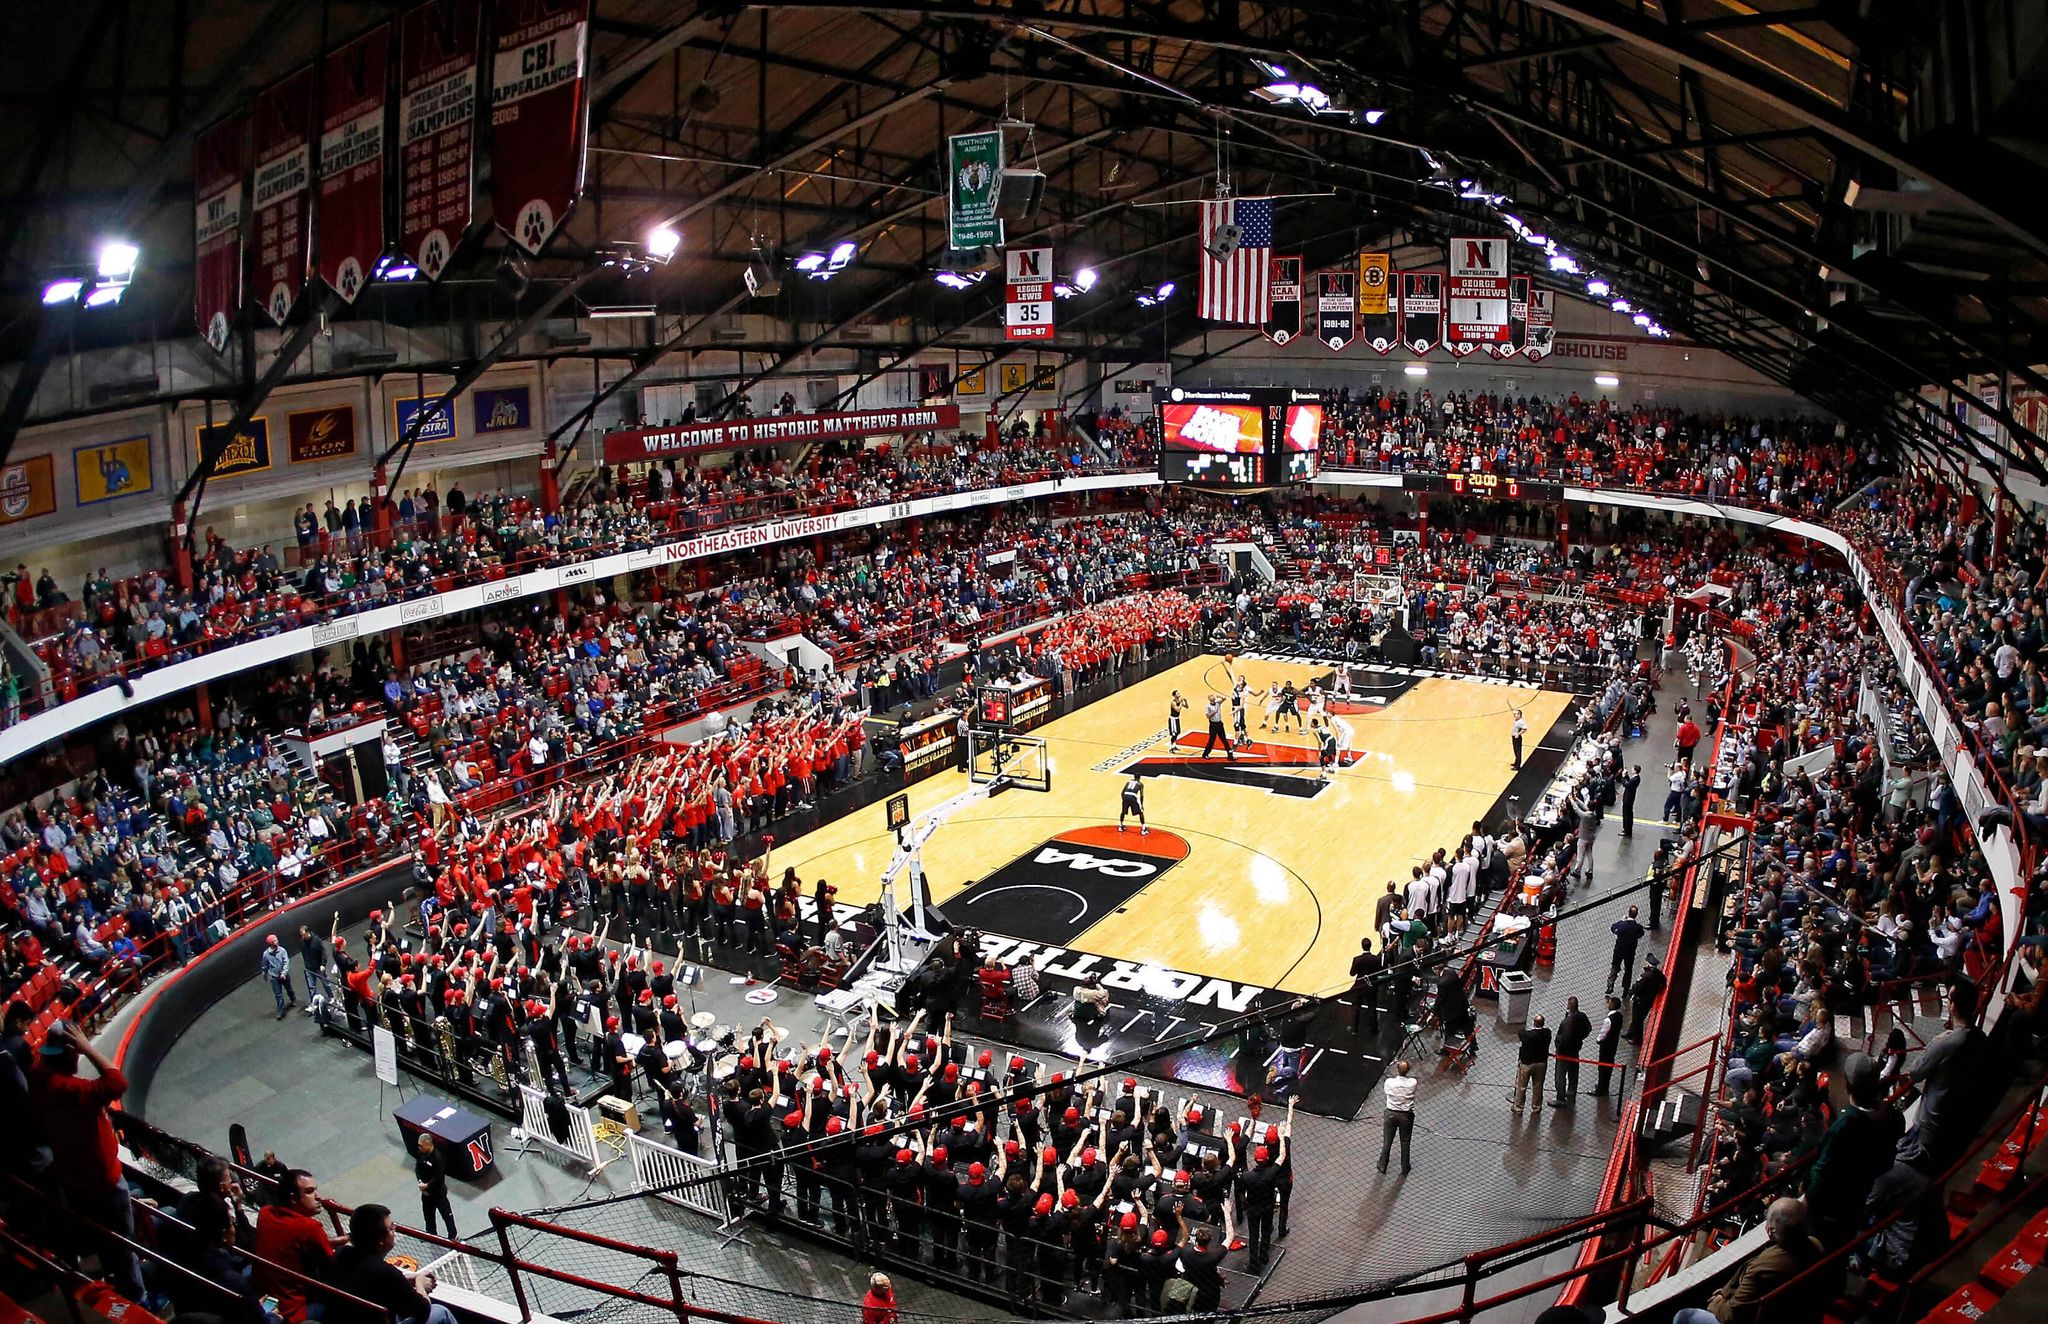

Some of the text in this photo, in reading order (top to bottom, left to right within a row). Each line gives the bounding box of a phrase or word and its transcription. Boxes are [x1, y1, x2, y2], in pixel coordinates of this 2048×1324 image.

[522, 39, 556, 74] CBI
[491, 105, 519, 125] 2009
[1467, 241, 1492, 269] N
[1019, 251, 1040, 277] N
[1328, 274, 1345, 293] N
[1369, 269, 1380, 284] B
[1413, 275, 1431, 294] N
[1462, 279, 1496, 288] GEORGE
[1016, 285, 1042, 293] REGGIE
[1017, 292, 1042, 301] LEWIS
[1451, 287, 1507, 297] MATTHEWS
[1020, 305, 1040, 322] 35
[1476, 302, 1482, 321] 1
[1323, 320, 1350, 328] 1981-82
[1458, 325, 1500, 333] CHAIRMAN
[1554, 342, 1628, 361] GHOUSE
[1184, 391, 1251, 400] Northeastern University
[1269, 406, 1281, 420] N
[485, 415, 520, 429] JMU
[643, 411, 938, 453] WELCOME TO HISTORIC MATTHEWS ARENA
[299, 441, 346, 454] ELON
[1455, 479, 1462, 491] 0
[1468, 473, 1498, 487] 20:00
[1487, 487, 1492, 496] 1
[1510, 484, 1517, 496] 0
[666, 515, 839, 561] NORTHEASTERN UNIVERSITY
[486, 585, 520, 601] ARMS
[1239, 652, 1544, 690] NORTHEASTERN
[1090, 728, 1168, 773] ORTHEASTERN
[1033, 847, 1157, 877] CAA
[1481, 965, 1506, 992] N
[466, 1131, 494, 1173] N
